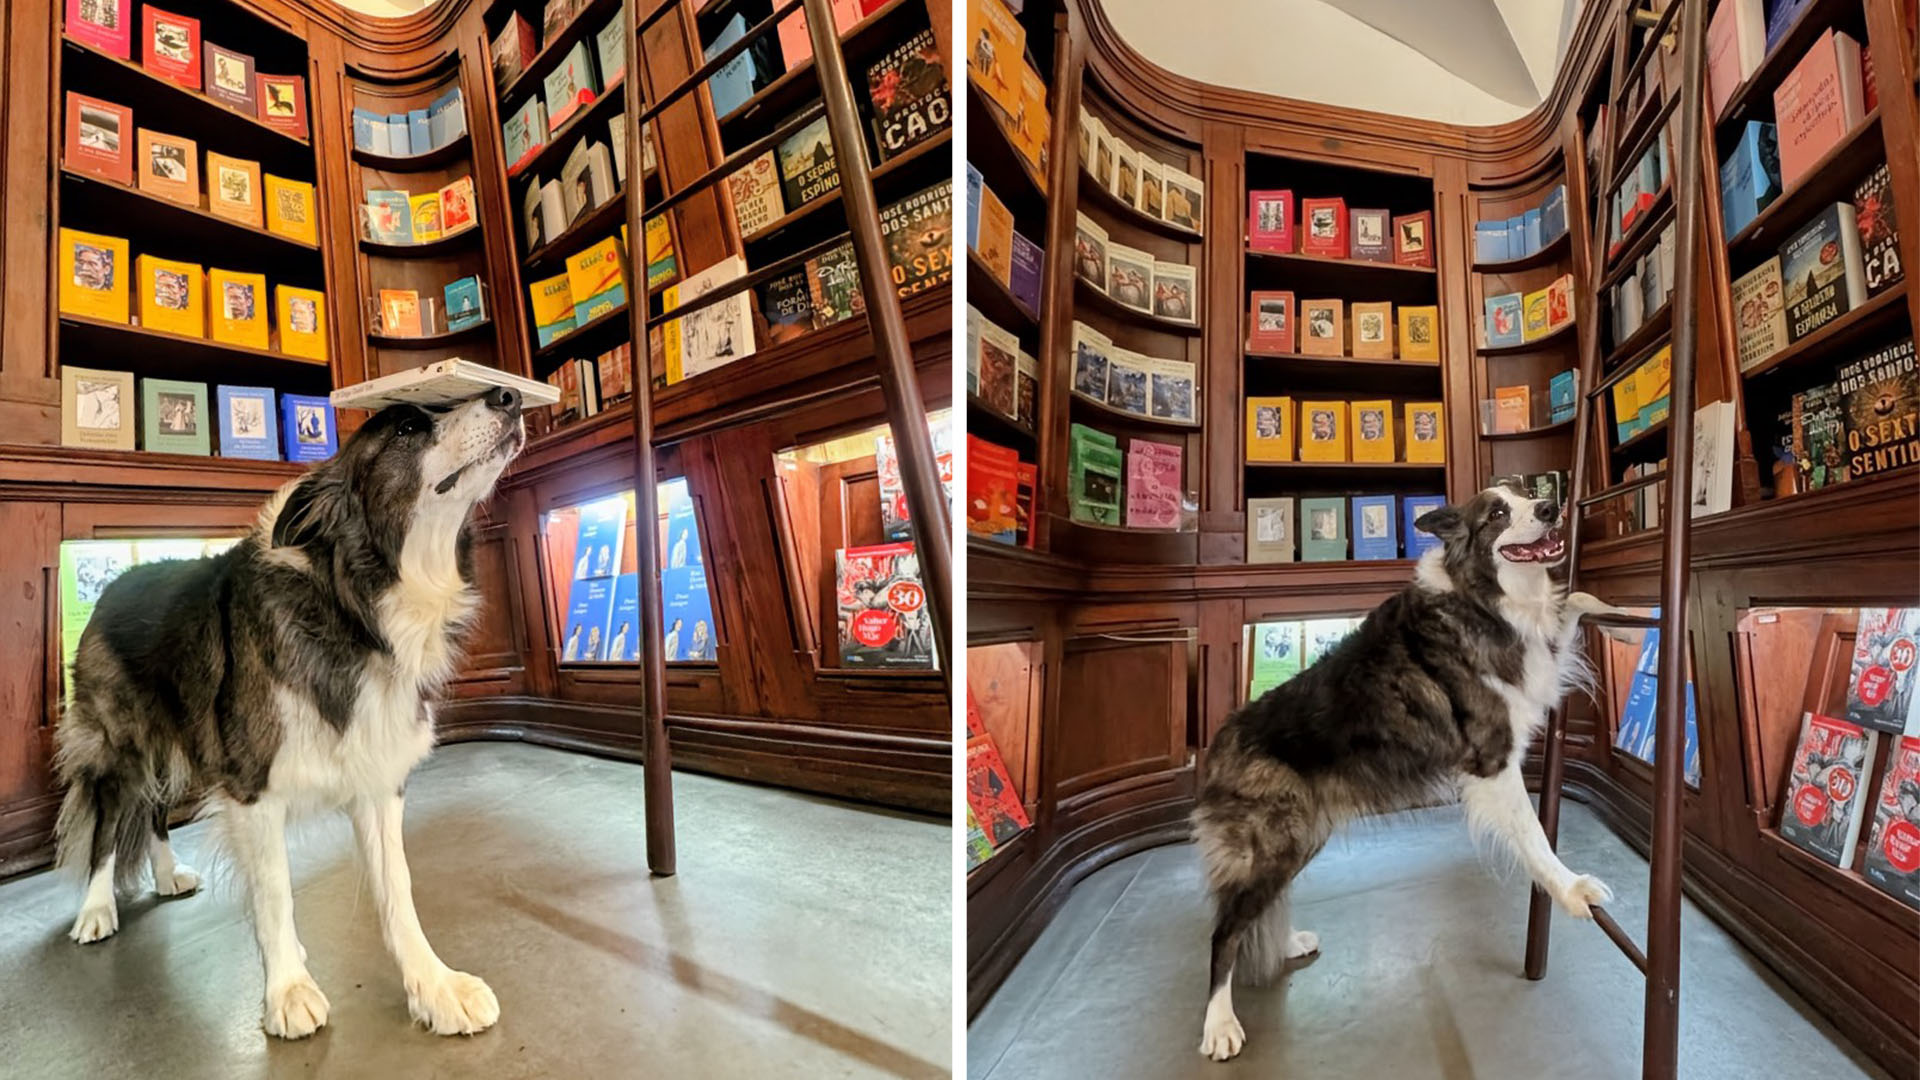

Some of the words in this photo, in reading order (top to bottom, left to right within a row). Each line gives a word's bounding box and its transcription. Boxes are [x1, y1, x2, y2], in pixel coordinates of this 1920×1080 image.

[869, 53, 892, 76] JOSÉ
[894, 27, 934, 58] RODRIG
[881, 59, 900, 76] DOS
[885, 97, 950, 150] CAO
[798, 175, 806, 187] O
[806, 157, 837, 182] SEGRE
[801, 172, 840, 203] ESPINO
[736, 198, 764, 217] ULHER
[905, 183, 952, 211] RODRIGU
[881, 214, 909, 236] DOS
[913, 196, 951, 223] SANT
[892, 265, 906, 284] O
[1866, 247, 1901, 289] CA
[1849, 430, 1860, 451] O
[1866, 413, 1917, 447] SEXT
[1852, 440, 1920, 475] SENTID
[893, 589, 920, 607] 30
